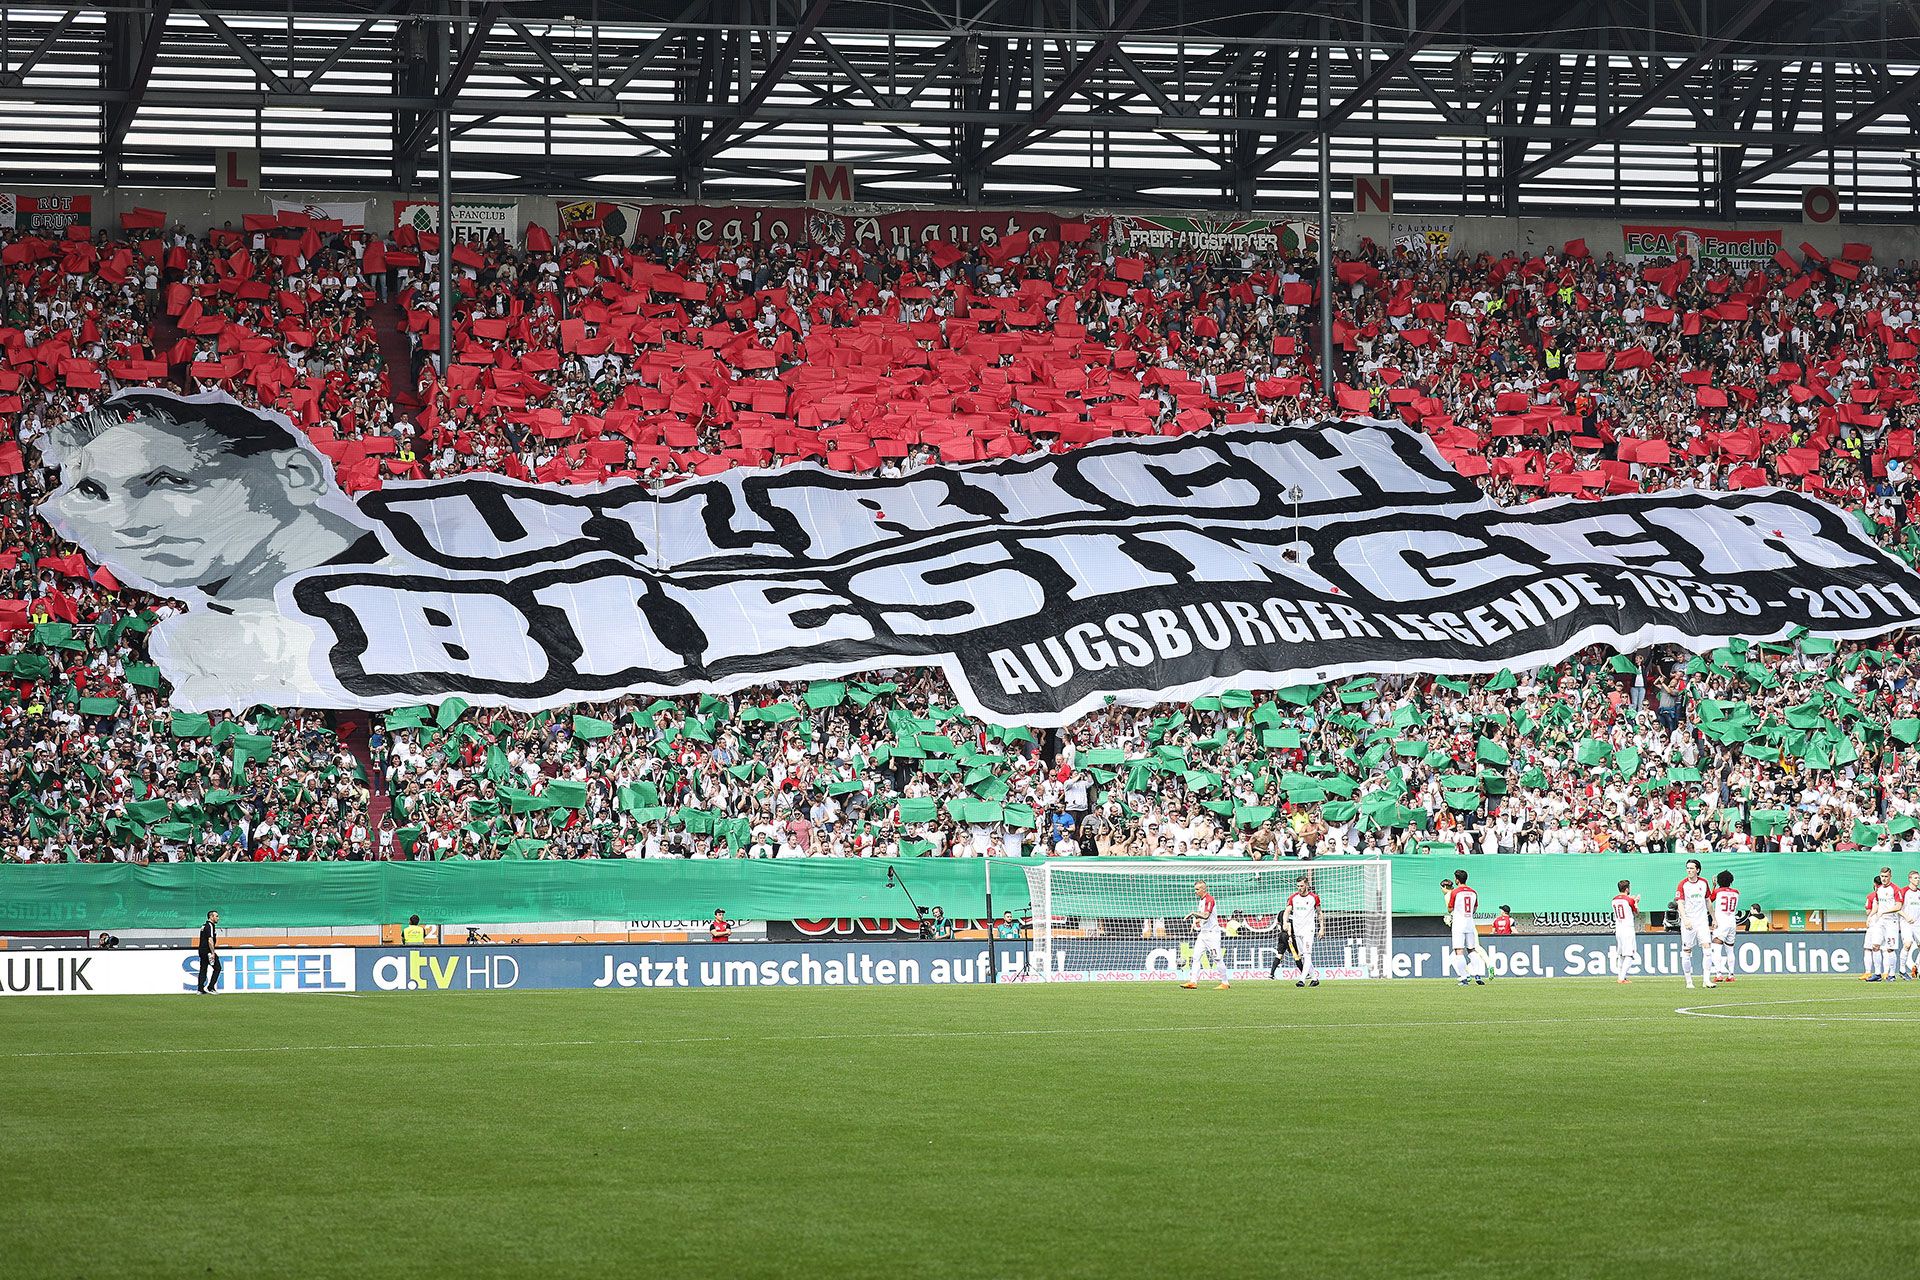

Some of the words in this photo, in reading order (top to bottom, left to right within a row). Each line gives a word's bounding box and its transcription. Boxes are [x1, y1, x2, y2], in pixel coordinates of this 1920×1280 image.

[227, 151, 249, 188] L
[809, 165, 851, 200] M
[1356, 178, 1390, 213] N
[1804, 187, 1839, 223] O
[436, 210, 506, 220] FA-FANCLUB
[1627, 233, 1672, 253] FCA
[1705, 237, 1778, 256] Fanclub
[384, 426, 1458, 571] ULRICH
[324, 501, 1880, 684] BIESINGER
[986, 596, 1383, 695] AUGSBURGER
[1372, 572, 1626, 648] LEGENDE,
[1614, 570, 1762, 616] 1933
[1788, 582, 1920, 619] 2011
[1464, 896, 1471, 913] 8
[1613, 904, 1625, 920] 10
[1720, 895, 1737, 912] 30
[1808, 910, 1821, 925] 4
[0, 957, 94, 992] ULIK
[181, 954, 346, 991] STIEFEL
[466, 955, 520, 990] HD
[592, 954, 690, 988] Jetzt
[699, 951, 920, 987] umschalten
[930, 950, 990, 984] auf
[1563, 942, 1694, 977] Satelli
[1738, 941, 1850, 974] Online
